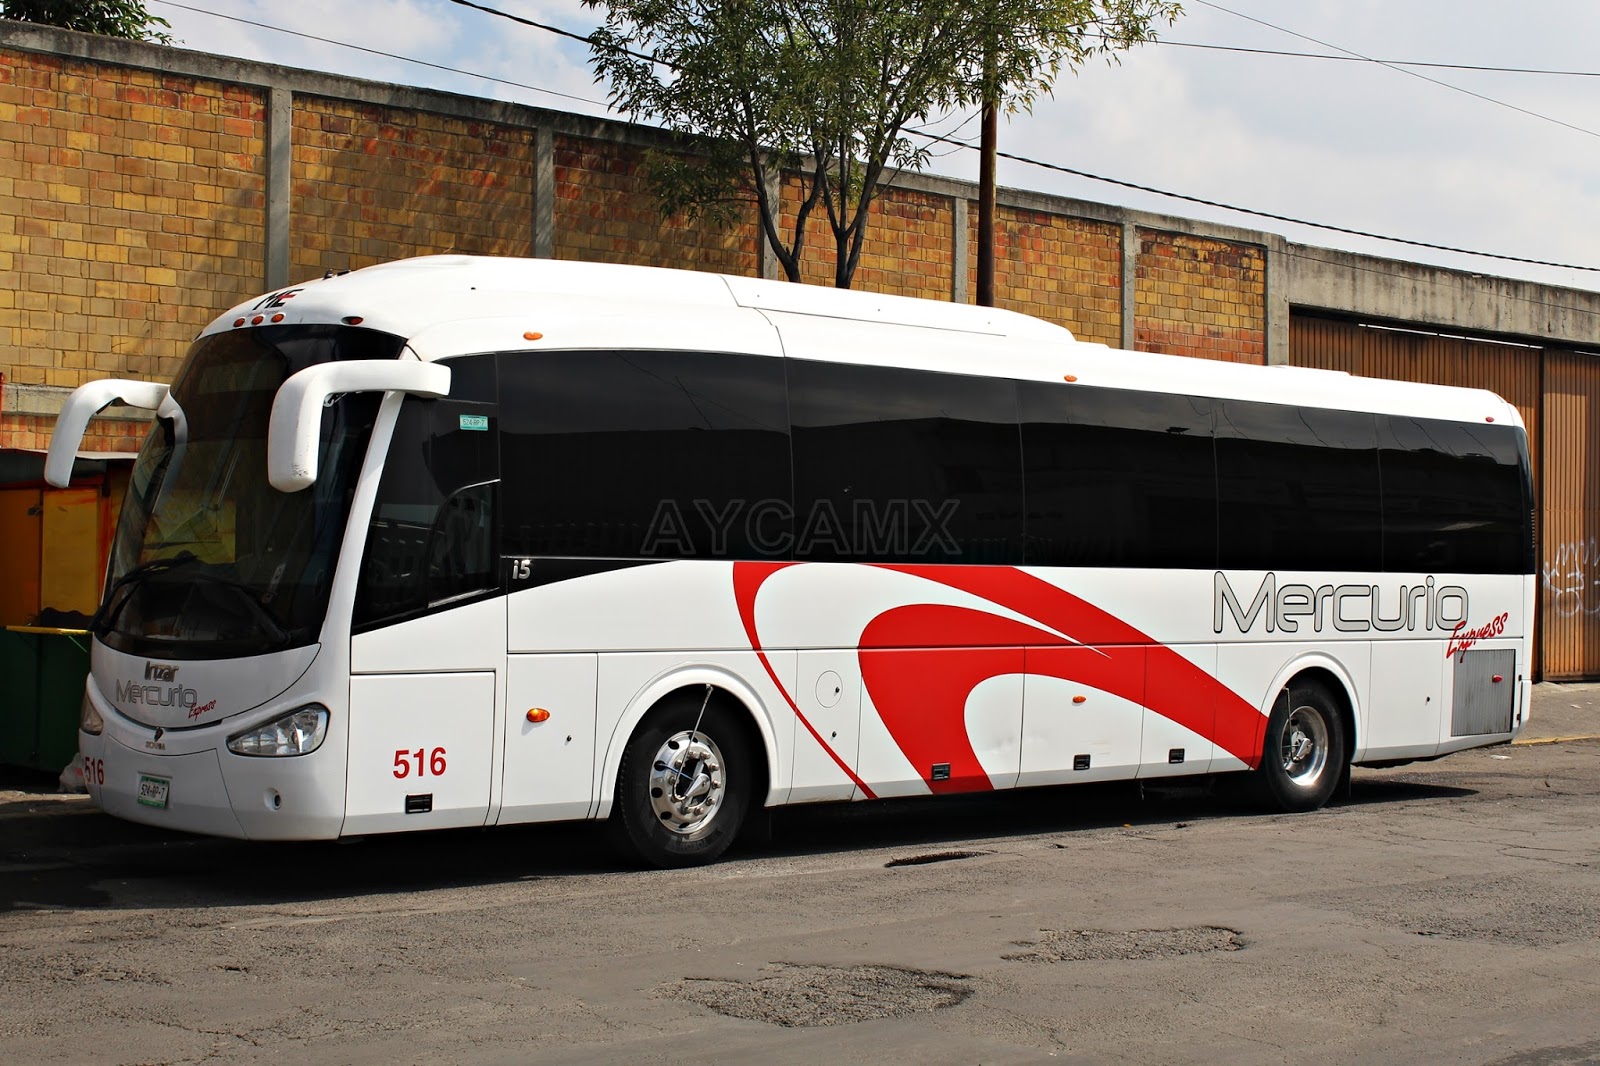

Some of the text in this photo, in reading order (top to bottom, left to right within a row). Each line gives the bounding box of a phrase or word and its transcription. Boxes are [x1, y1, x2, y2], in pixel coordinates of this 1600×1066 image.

[1213, 570, 1469, 634] Mercurio
[1446, 612, 1509, 664] Express
[116, 679, 198, 708] Mercurio
[187, 699, 217, 722] Express
[84, 756, 105, 785] 516
[393, 746, 447, 779] 516
